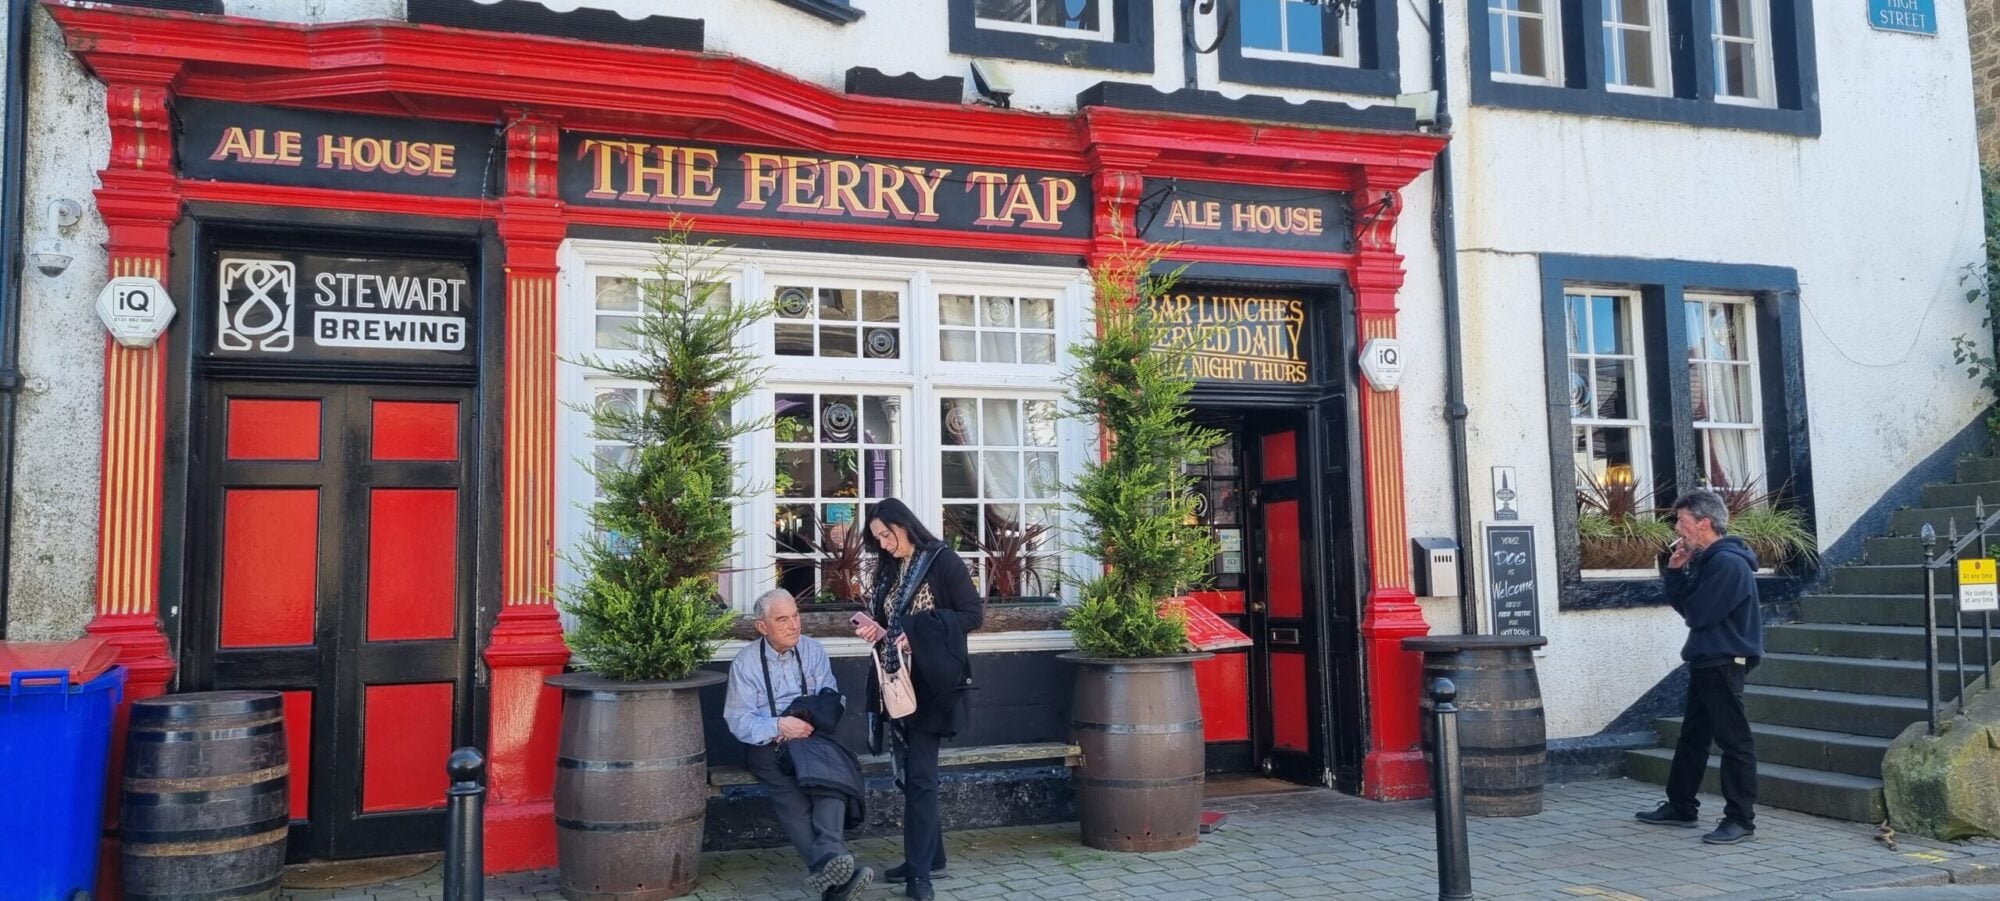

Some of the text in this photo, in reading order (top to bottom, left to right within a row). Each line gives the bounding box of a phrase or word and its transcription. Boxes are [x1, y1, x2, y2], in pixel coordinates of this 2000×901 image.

[1880, 10, 1925, 28] STREET
[1887, 0, 1918, 10] HIGH
[210, 127, 457, 177] ALE HOUSE
[577, 139, 1076, 230] THE FERRY TAP
[1164, 200, 1323, 235] ALE HOUSE
[119, 290, 149, 312] iQ
[314, 272, 466, 312] STEWART
[1197, 296, 1304, 324] LUNCHES
[321, 314, 460, 344] BREWING
[1149, 325, 1304, 360] ERVED DAILY
[1192, 356, 1247, 381] NIGHT
[1250, 361, 1307, 384] THURS
[1379, 348, 1398, 366] iQ
[1494, 550, 1526, 566] DOG
[1491, 580, 1535, 600] Welcome
